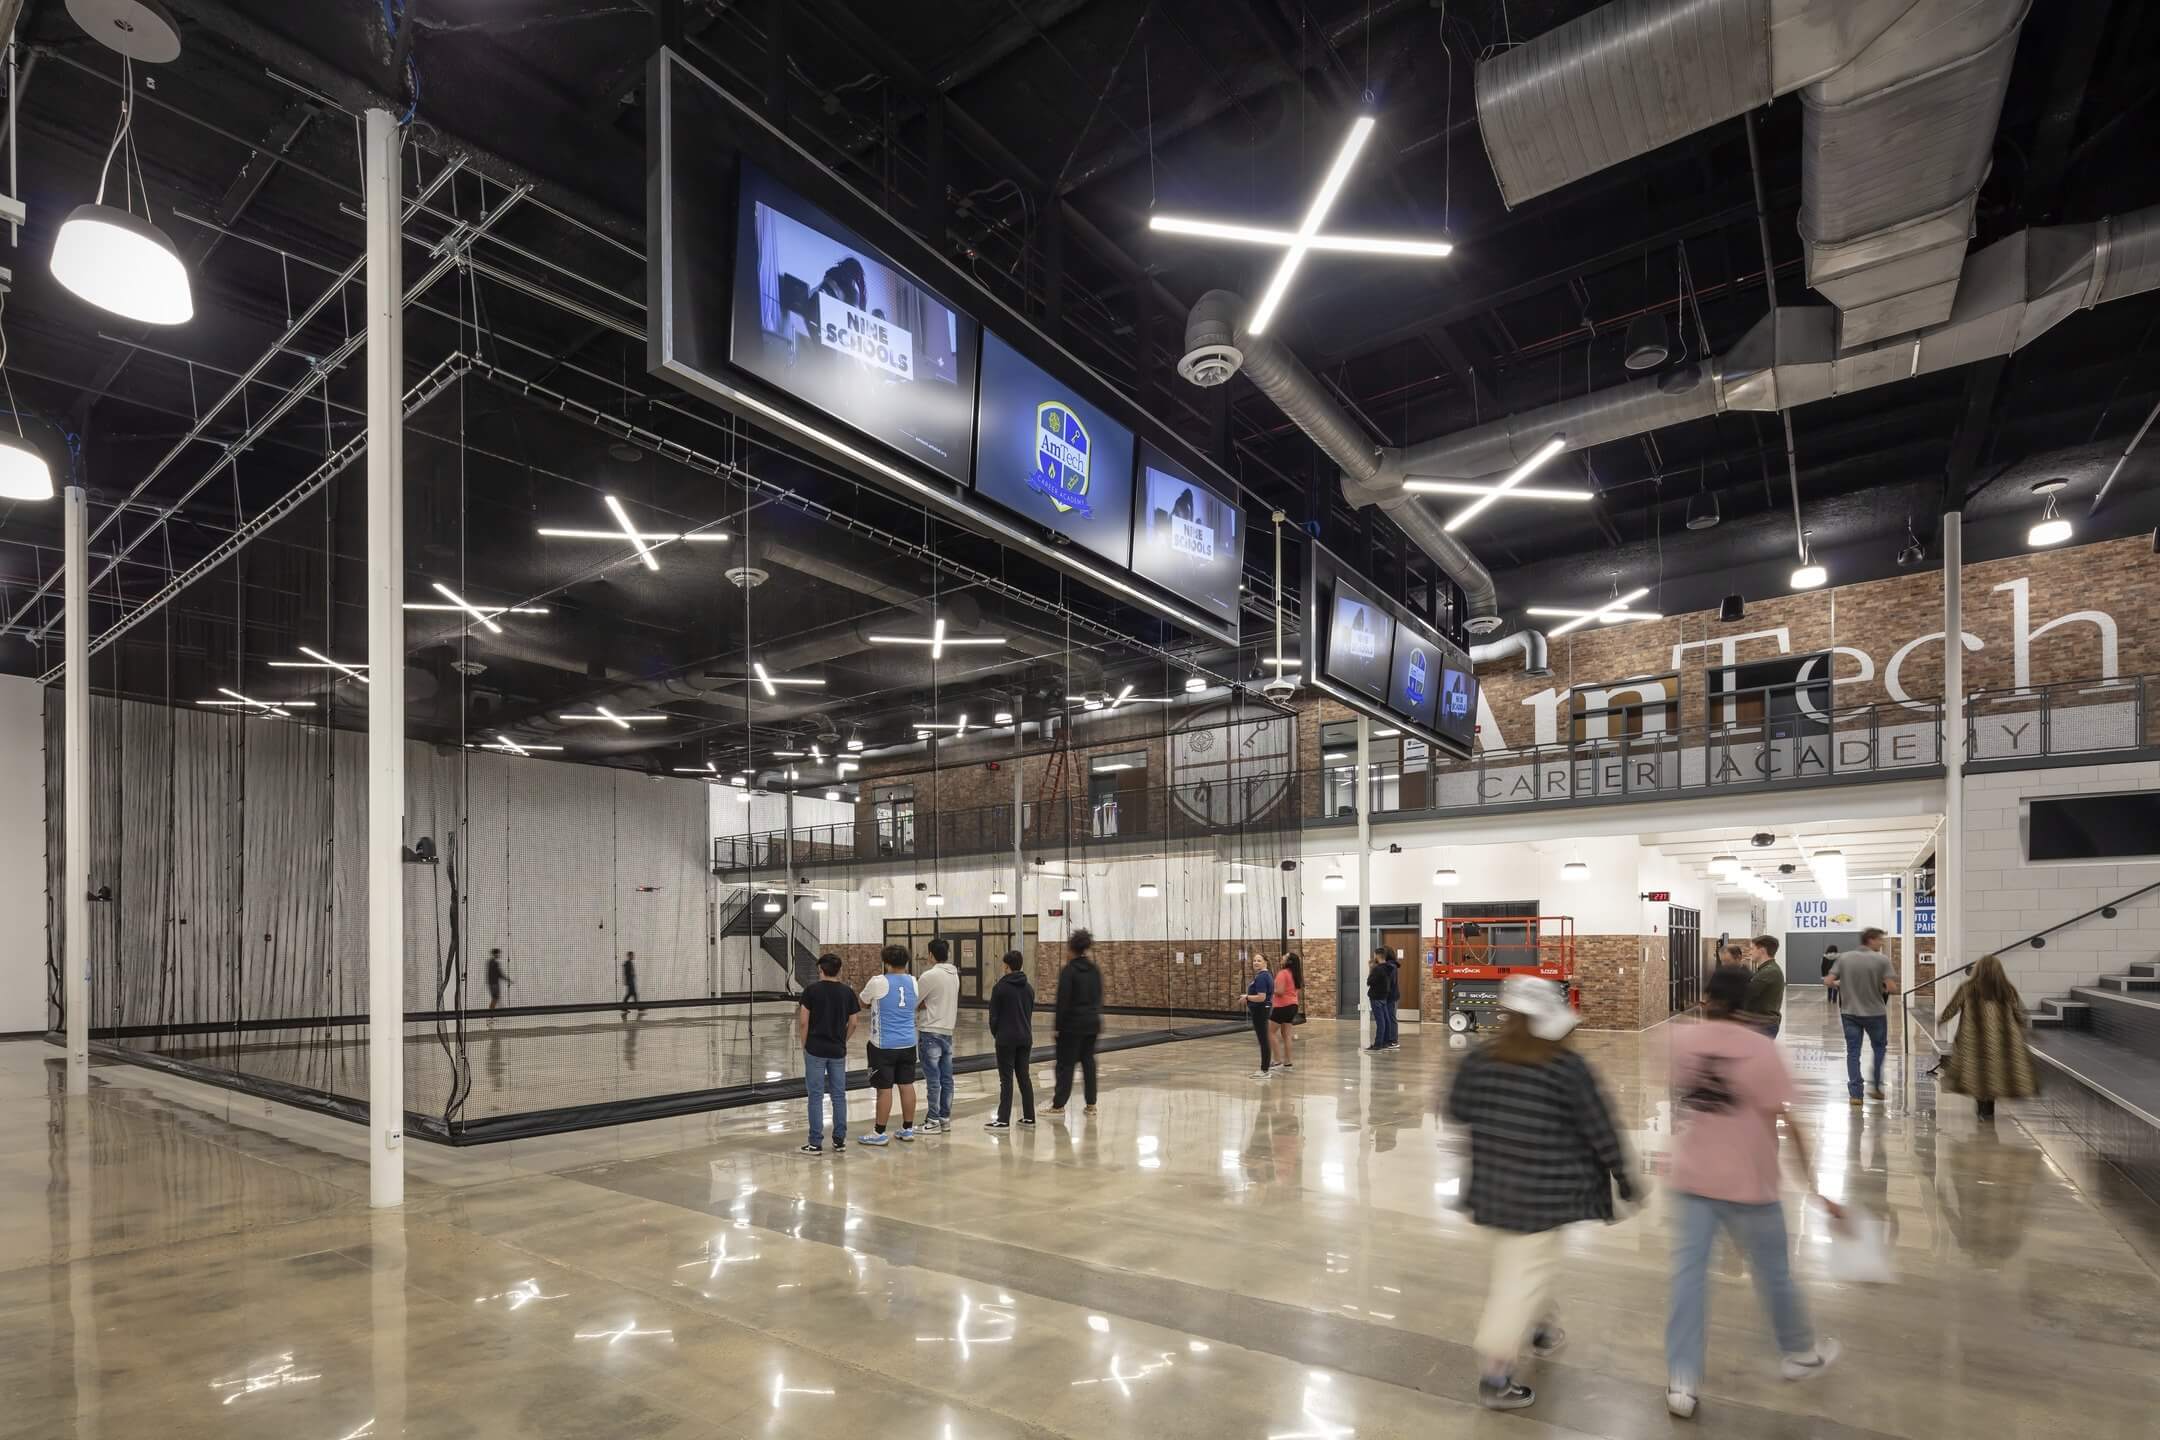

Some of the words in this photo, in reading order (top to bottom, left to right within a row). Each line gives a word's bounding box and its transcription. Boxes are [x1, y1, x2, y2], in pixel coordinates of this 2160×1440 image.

[847, 311, 889, 346] NINE
[826, 323, 908, 373] SCHOOLS
[1041, 434, 1084, 473] AmTech
[1037, 475, 1058, 495] CAREER
[1174, 533, 1212, 556] SCHOOLS
[1477, 762, 1656, 799] CAREER
[1795, 900, 1828, 914] AUTO
[1914, 913, 1929, 922] TO
[1795, 915, 1828, 928] TECH
[1914, 922, 1936, 932] PAIR
[898, 986, 906, 1007] 1
